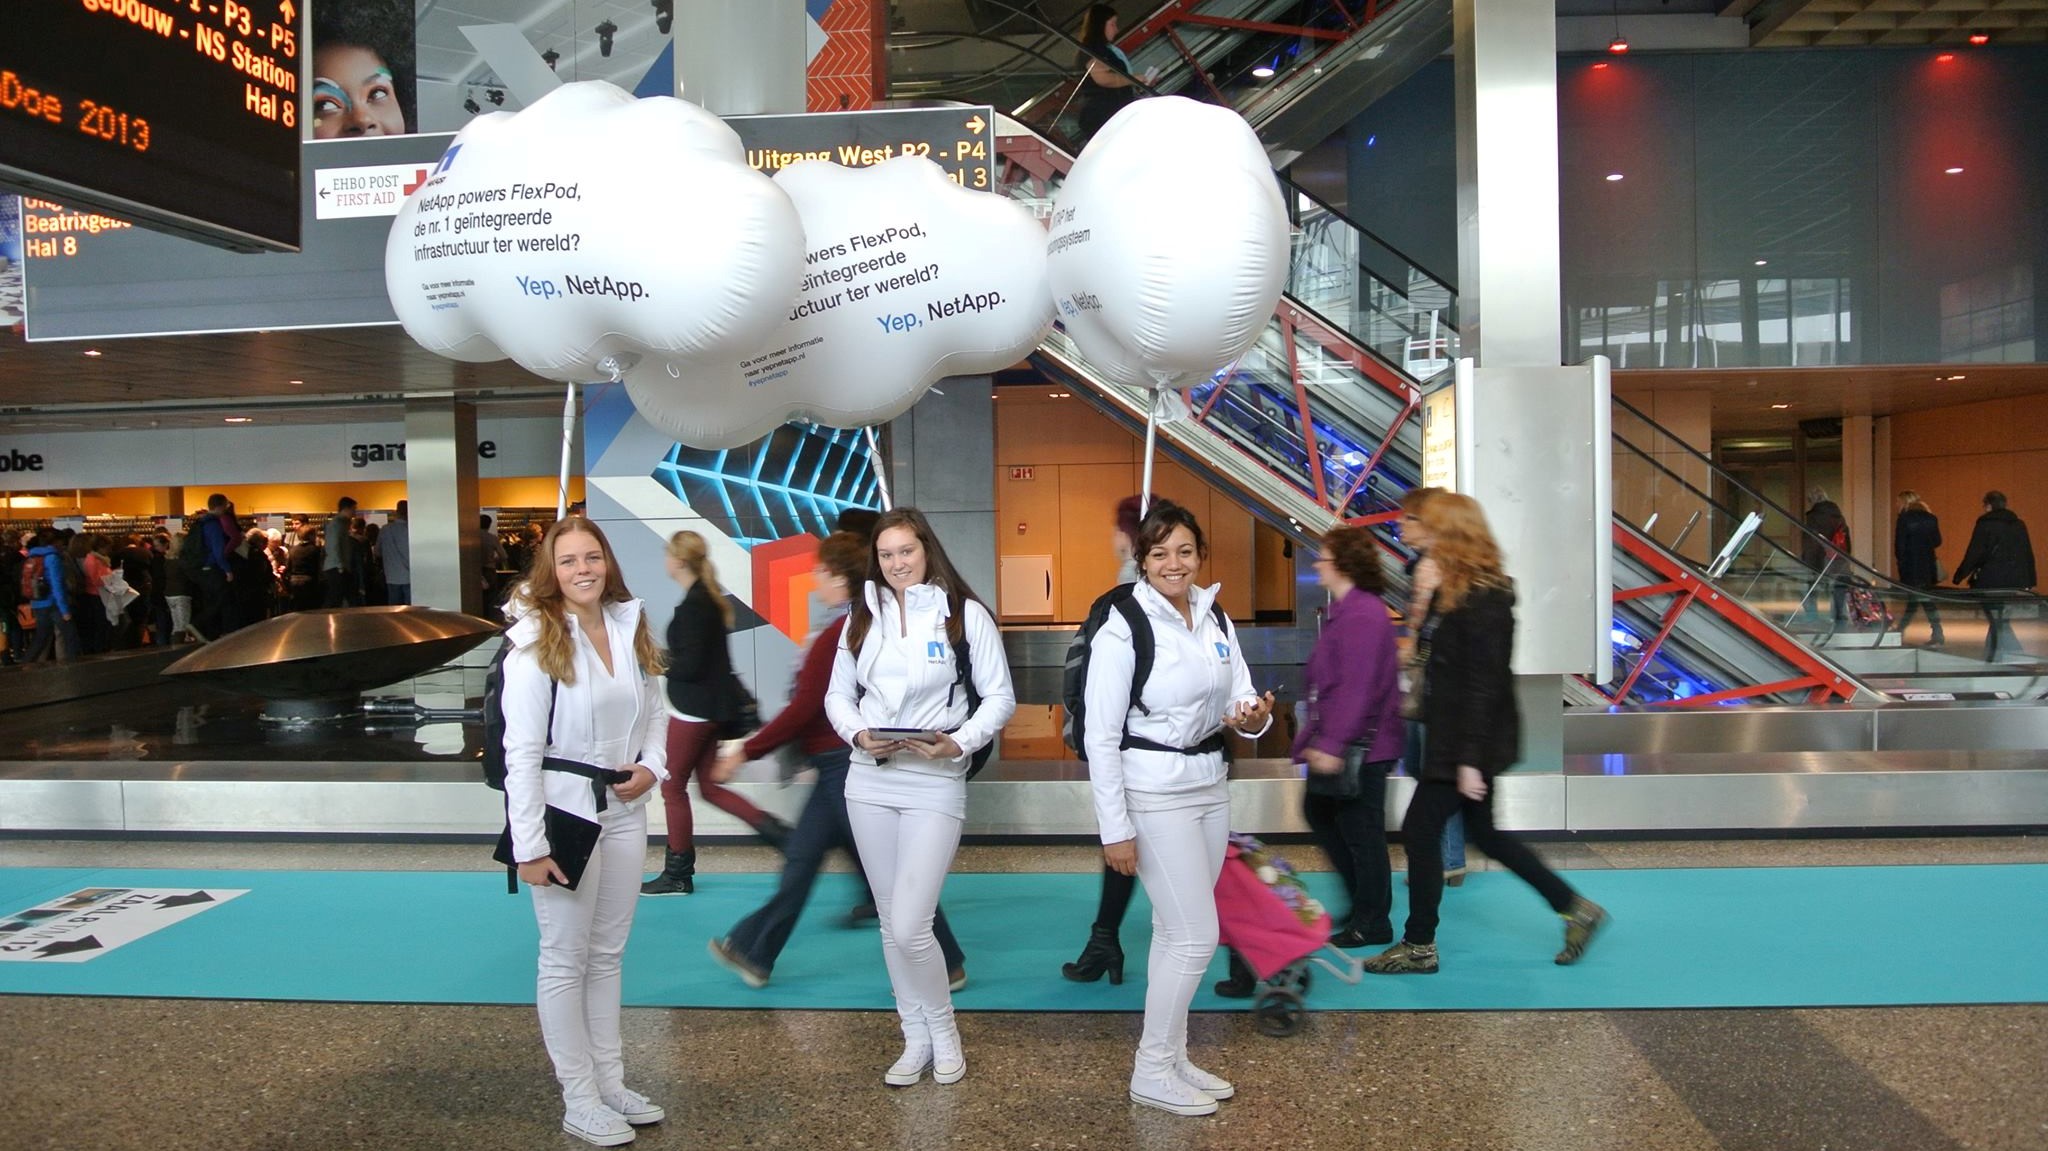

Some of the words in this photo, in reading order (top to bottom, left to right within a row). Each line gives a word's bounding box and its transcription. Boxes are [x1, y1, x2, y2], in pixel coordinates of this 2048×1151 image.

[224, 0, 251, 36] P3
[271, 23, 295, 57] P5
[197, 23, 226, 61] NS
[232, 41, 295, 93] Station
[1, 70, 62, 123] Doe
[80, 100, 149, 151] 2013
[246, 83, 276, 120] Hal
[283, 100, 295, 127] 8
[838, 145, 893, 166] West
[957, 141, 986, 161] P4
[333, 177, 366, 191] EHBO
[369, 175, 399, 189] POST
[974, 167, 987, 187] 3
[337, 193, 370, 206] FIRST
[373, 191, 396, 205] AID
[417, 193, 455, 214] NetApp
[457, 188, 507, 208] powers
[511, 183, 582, 202] FlexPod,
[25, 212, 132, 233] Beatrixge
[414, 222, 426, 237] de
[428, 220, 441, 234] nr.
[444, 216, 450, 231] 1
[454, 208, 552, 234] geïntegreerde
[26, 238, 57, 257] Hal
[63, 236, 77, 256] 8
[414, 237, 490, 261] infrastructuur
[493, 237, 513, 253] ter
[517, 234, 581, 252] wereld?
[850, 222, 927, 252] FlexPod,
[516, 275, 562, 299] Yep,
[565, 274, 649, 301] NetApp.
[846, 285, 870, 302] ter
[875, 263, 939, 294] wereld?
[876, 312, 923, 334] Yep,
[927, 290, 1006, 321] NetApp.
[788, 336, 824, 352] informatie
